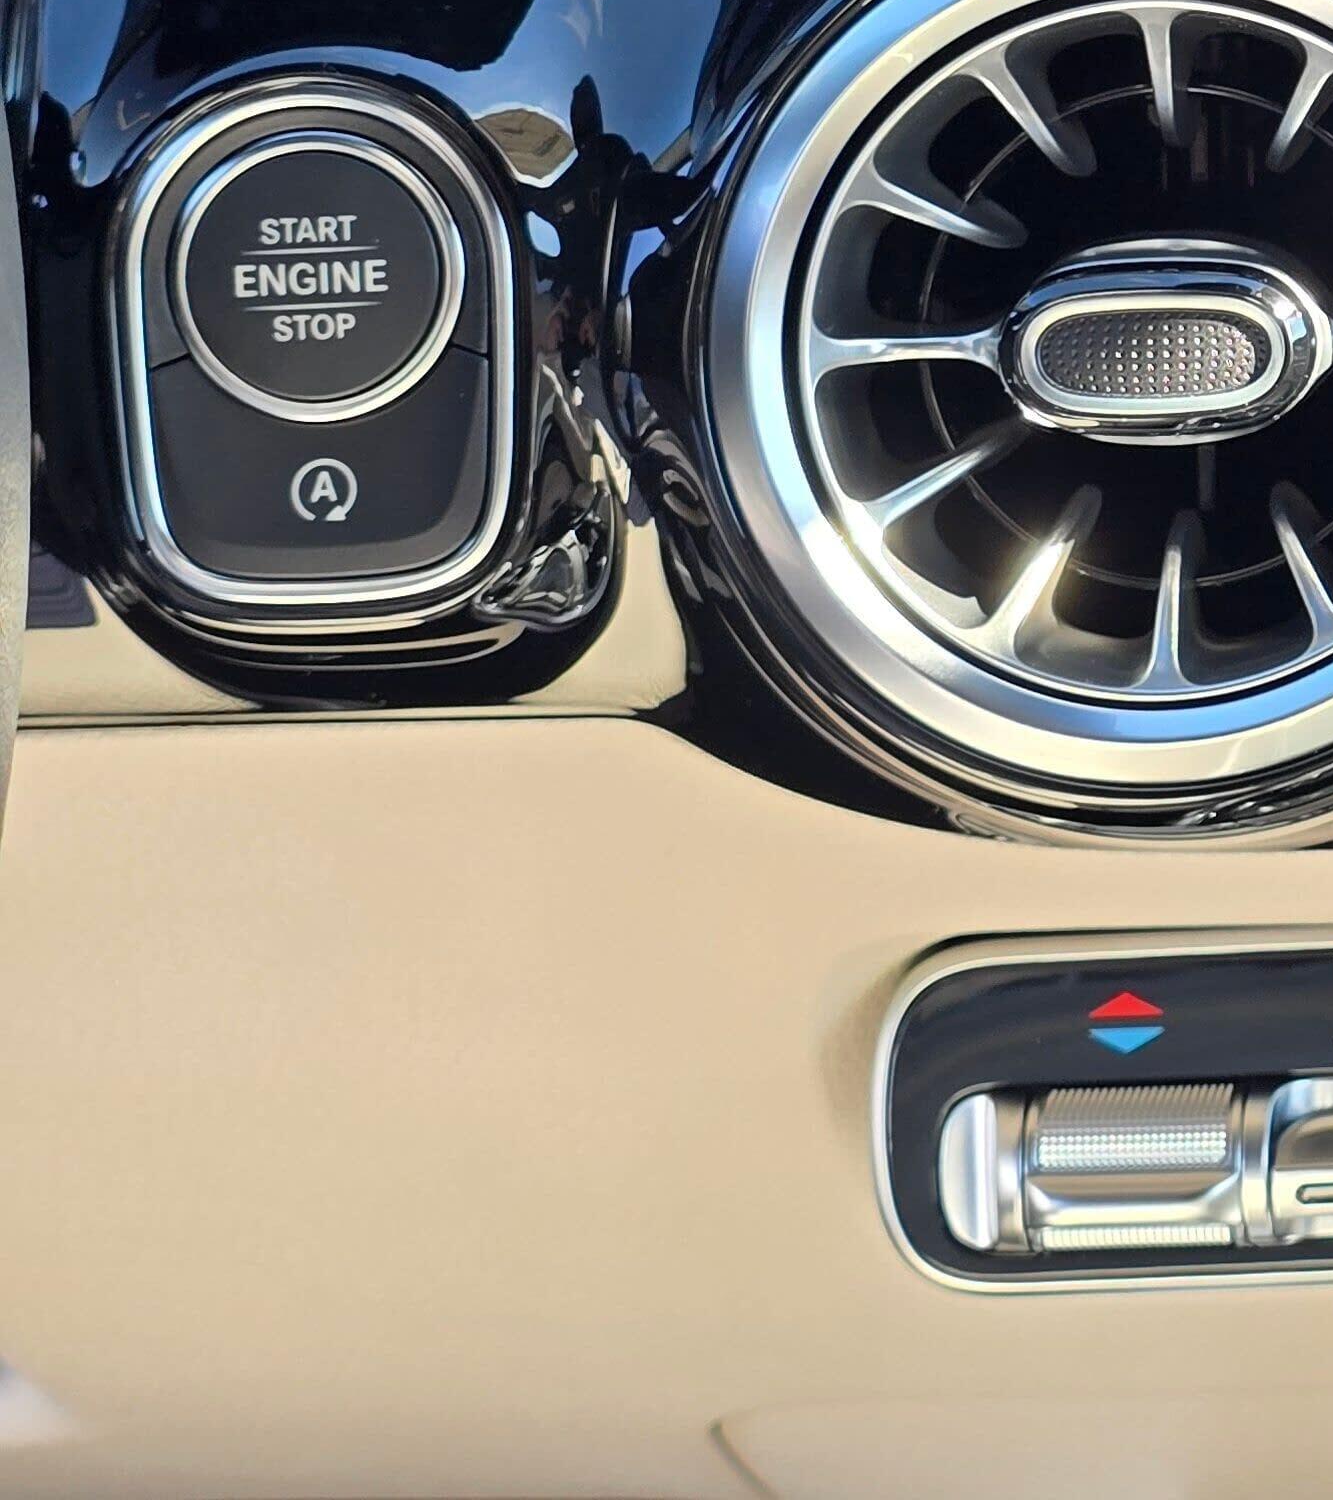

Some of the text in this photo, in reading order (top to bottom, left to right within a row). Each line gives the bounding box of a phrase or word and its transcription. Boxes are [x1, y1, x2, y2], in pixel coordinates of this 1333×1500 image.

[259, 214, 357, 245] START
[233, 259, 389, 298] ENGINE
[271, 312, 356, 342] STOP
